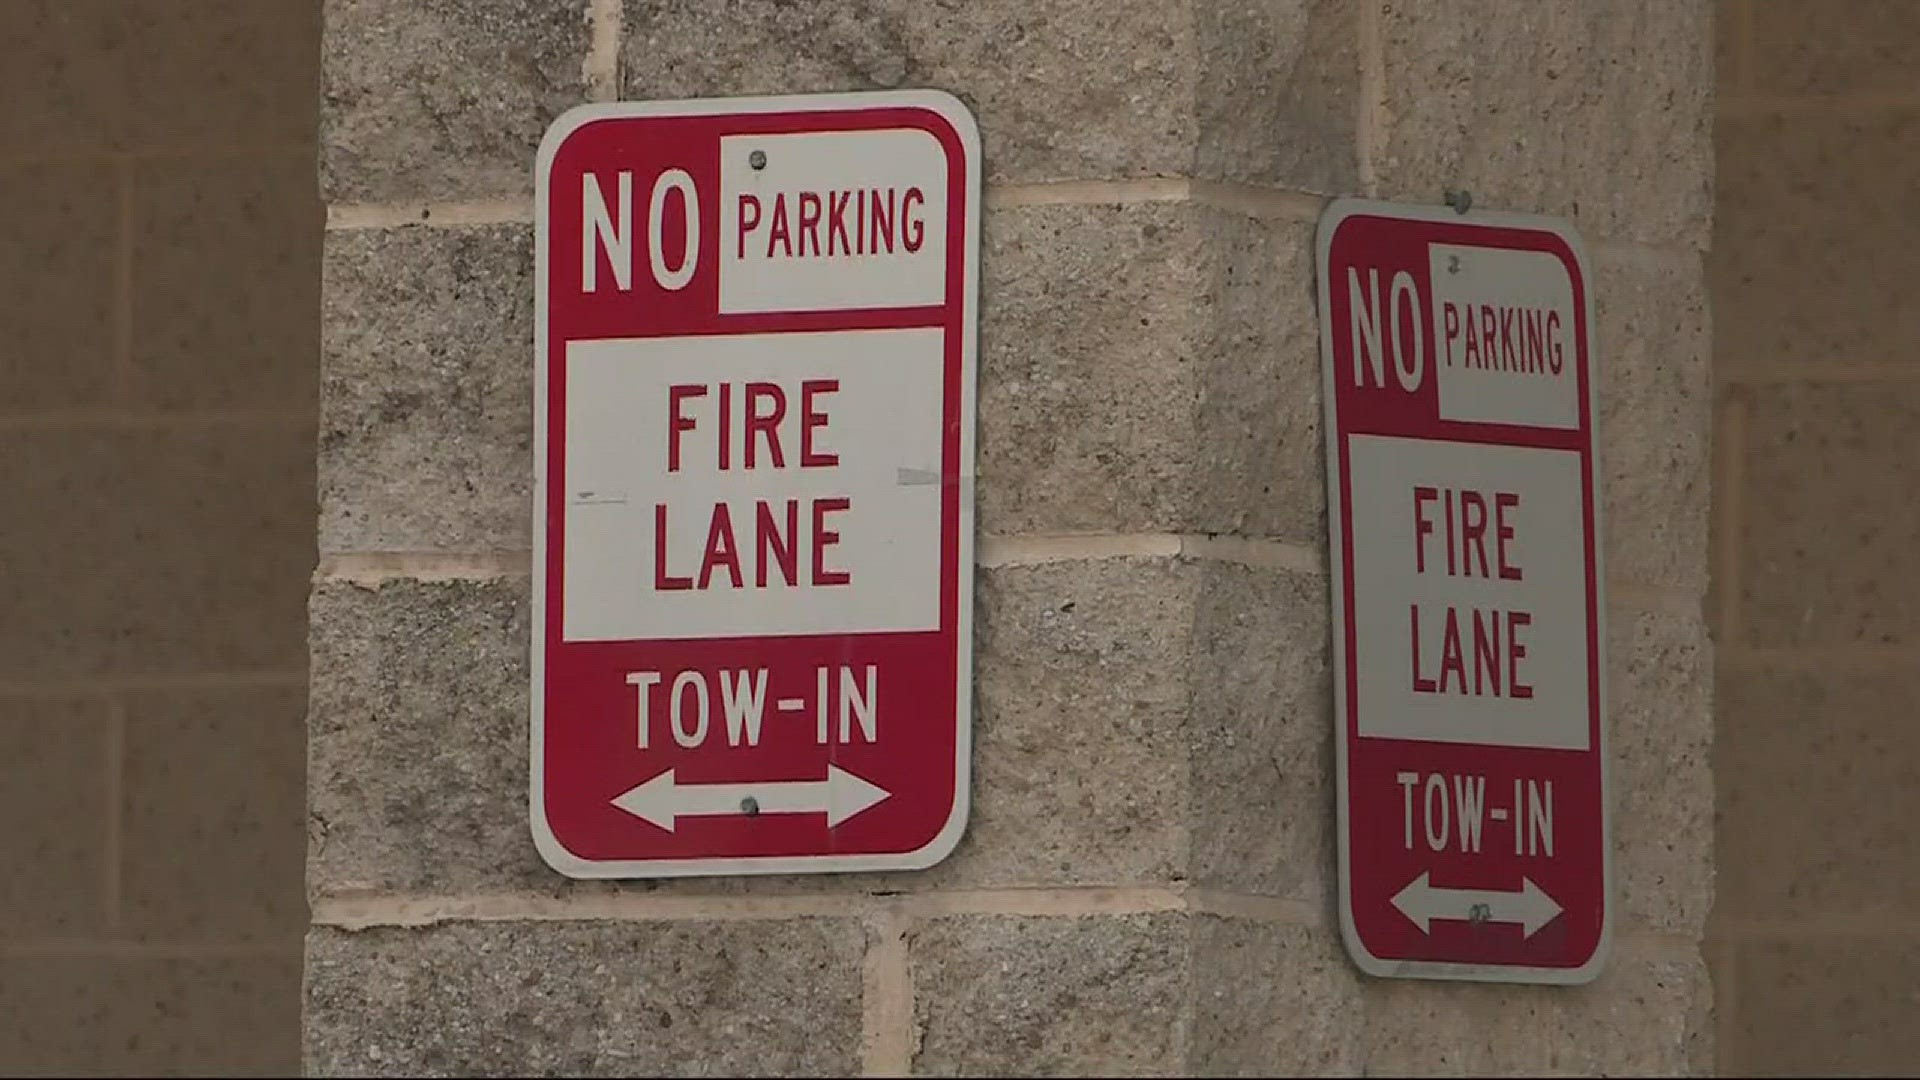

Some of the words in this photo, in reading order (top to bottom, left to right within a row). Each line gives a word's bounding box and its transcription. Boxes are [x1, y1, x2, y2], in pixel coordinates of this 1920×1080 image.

[582, 168, 700, 293] NO
[737, 187, 925, 259] PARKING
[1348, 266, 1424, 392] NO
[1444, 302, 1562, 375] PARKING
[668, 379, 839, 472] FIRE
[655, 497, 851, 590] LANE
[1414, 486, 1522, 581] FIRE
[1411, 604, 1533, 698] LANE
[626, 665, 878, 749] TOW-IN
[1397, 772, 1554, 857] TOW-IN
